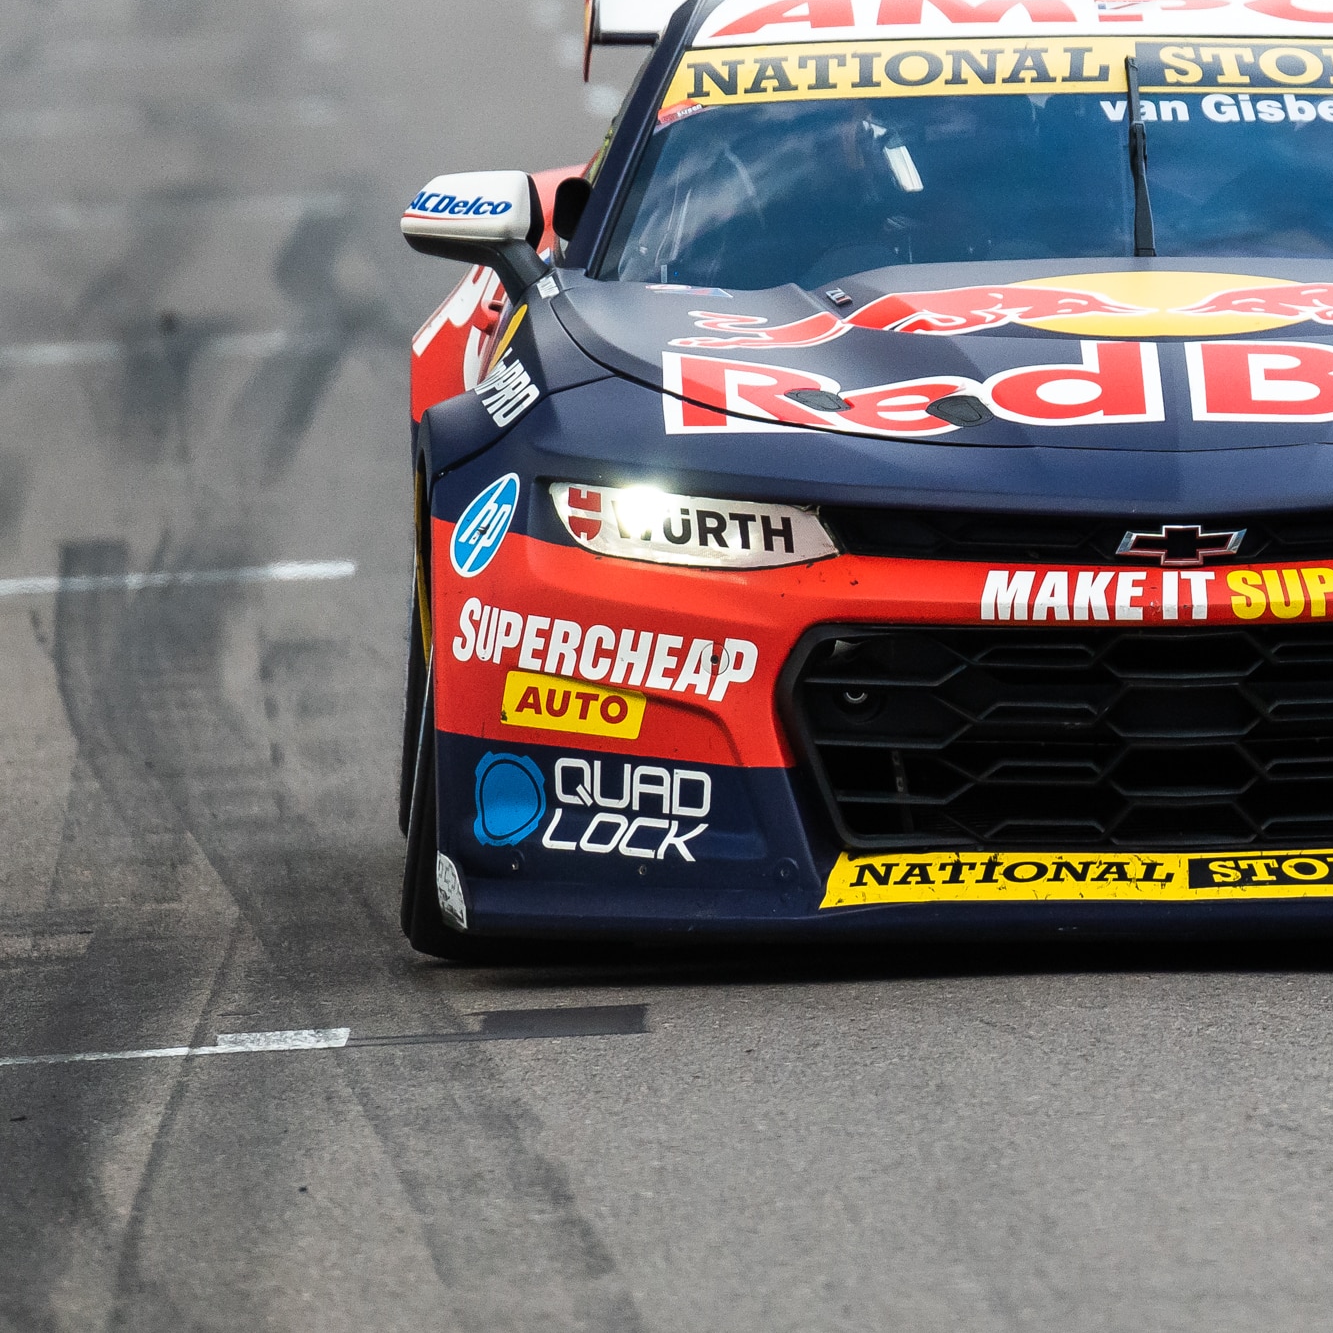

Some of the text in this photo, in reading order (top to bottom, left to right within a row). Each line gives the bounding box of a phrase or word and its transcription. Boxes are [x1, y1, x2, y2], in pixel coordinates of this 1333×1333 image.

[686, 45, 1111, 99] NATIONAL
[1099, 100, 1189, 123] van
[409, 191, 513, 216] ACDelco
[662, 340, 1165, 435] Red
[611, 500, 795, 554] ÜRTH
[980, 570, 1145, 621] MAKE
[1162, 570, 1215, 620] IT
[452, 597, 758, 702] SUPERCHEAP
[515, 686, 629, 725] AUTO
[553, 757, 712, 818] QUAD
[541, 807, 709, 862] LOCK
[848, 860, 1176, 888] NATIONAL
